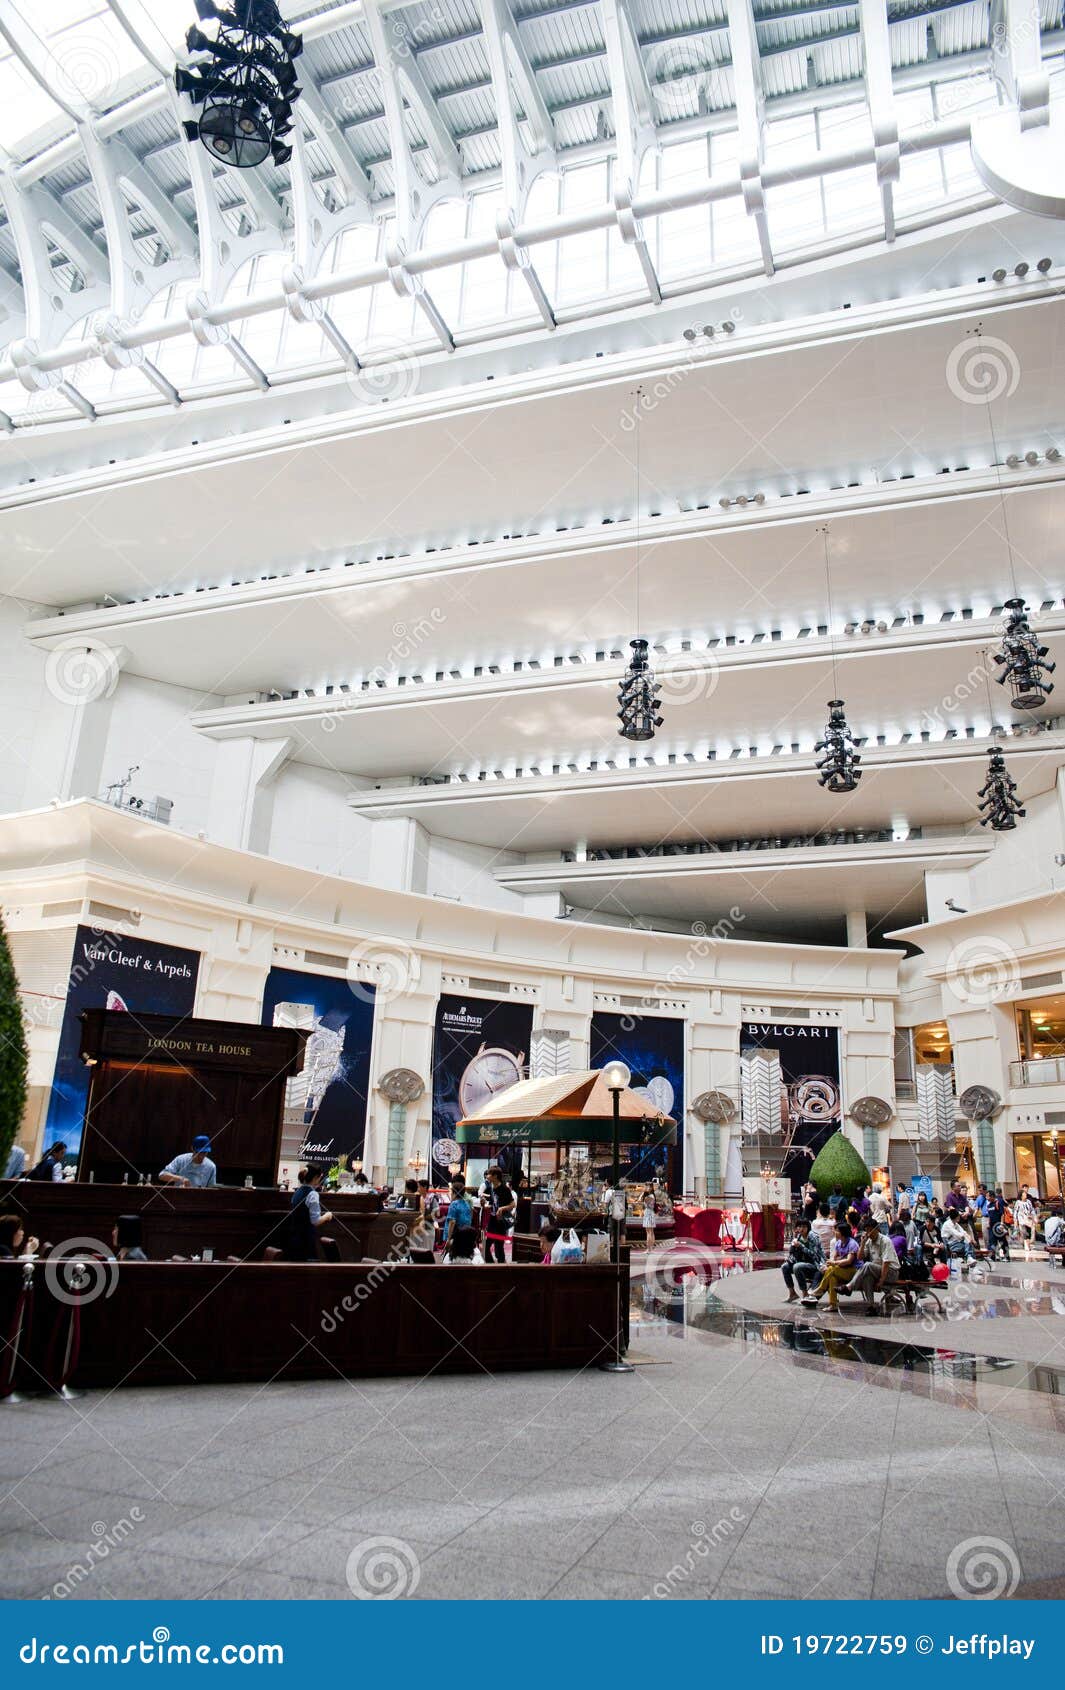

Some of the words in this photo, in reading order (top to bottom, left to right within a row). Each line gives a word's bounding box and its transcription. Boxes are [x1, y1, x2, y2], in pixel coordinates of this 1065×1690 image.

[83, 943, 105, 961] Van
[108, 949, 142, 968] Cleef
[143, 960, 153, 971] &
[155, 960, 192, 978] Arpels
[748, 1024, 829, 1038] BVLGARI
[147, 1039, 192, 1052] LONDON
[195, 1042, 214, 1053] TEA
[218, 1044, 252, 1057] HOUSE
[300, 1138, 334, 1155] pard
